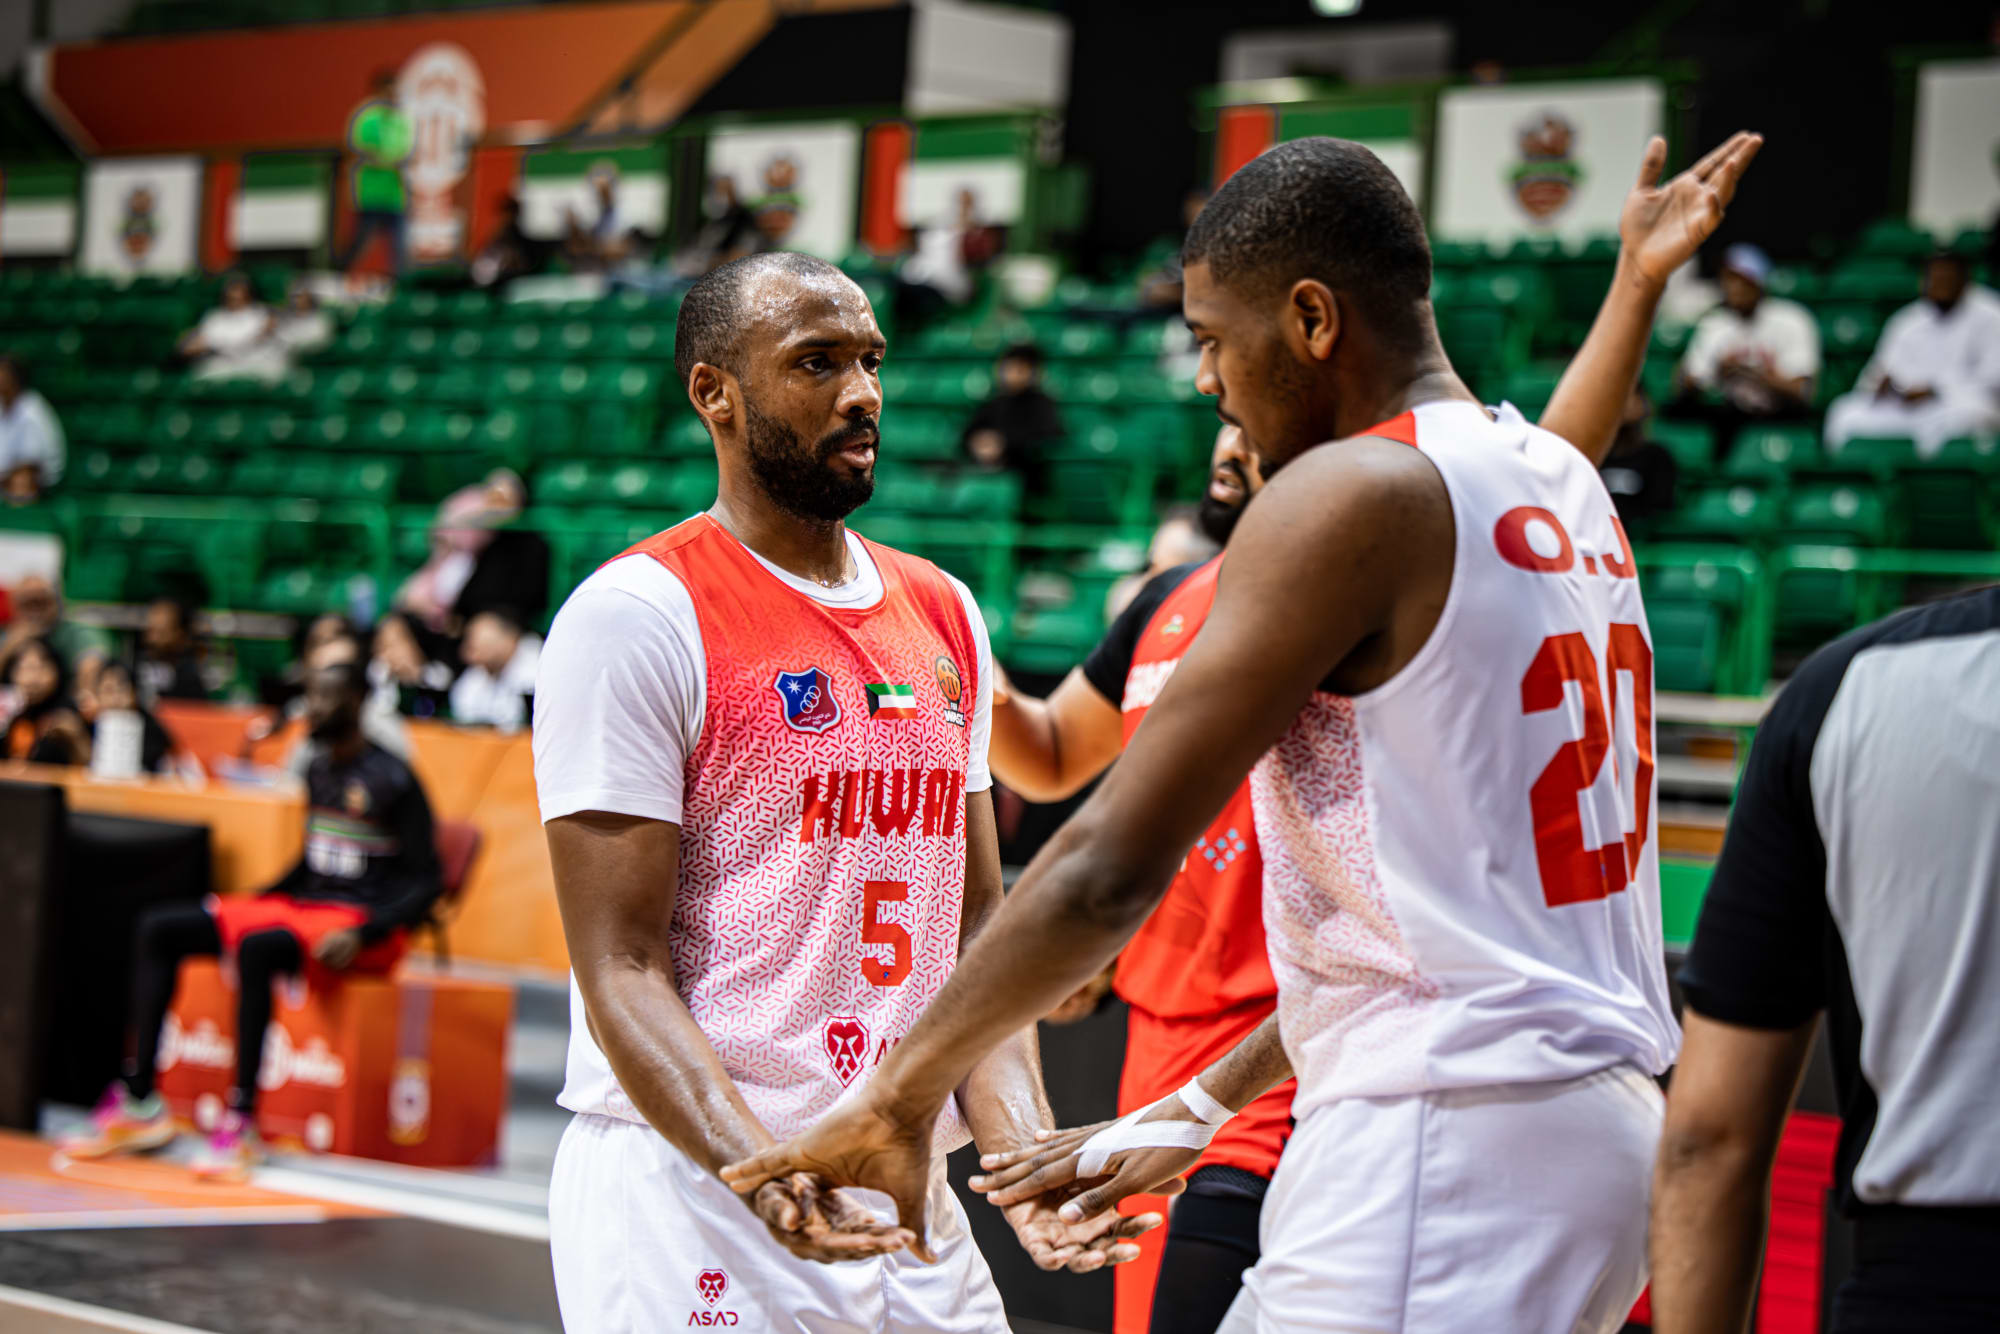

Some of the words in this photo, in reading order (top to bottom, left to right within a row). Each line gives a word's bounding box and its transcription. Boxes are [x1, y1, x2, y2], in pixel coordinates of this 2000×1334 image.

[1520, 622, 1654, 909] 20
[860, 880, 914, 987] 5
[688, 1311, 739, 1326] ASAD
